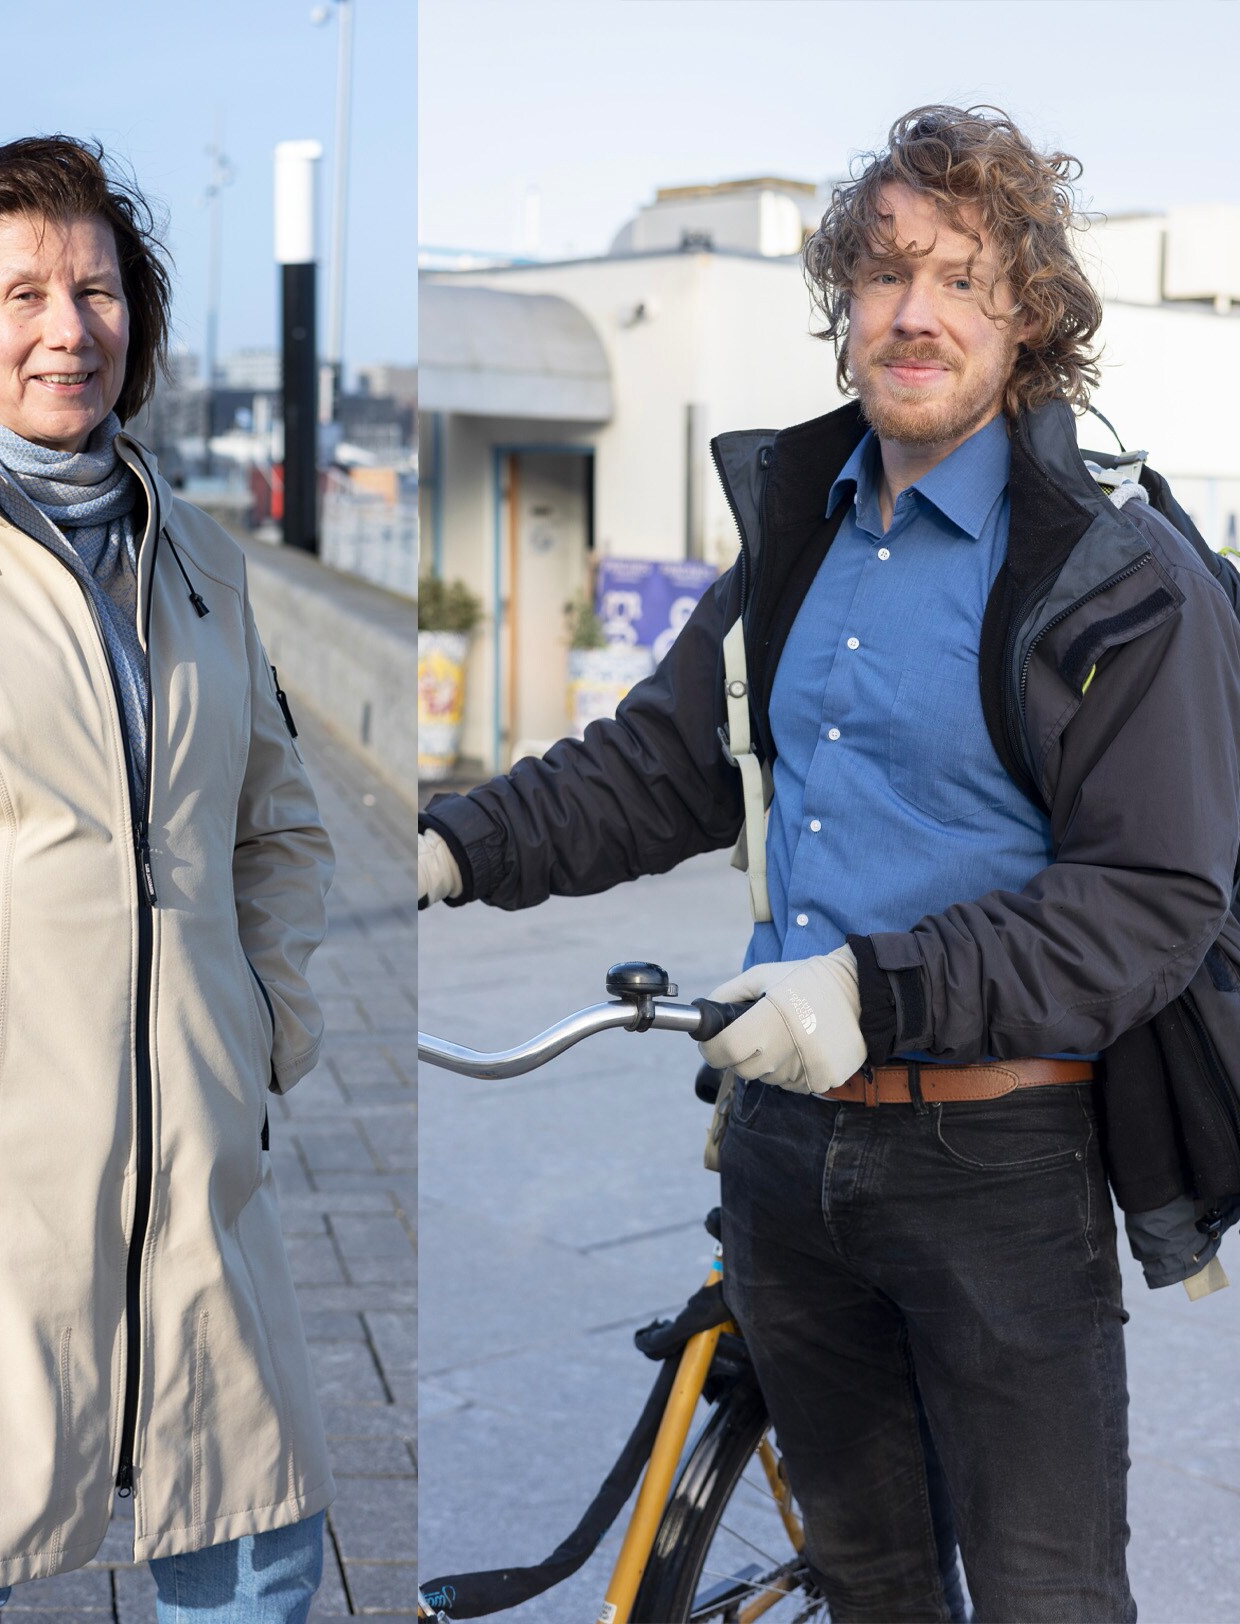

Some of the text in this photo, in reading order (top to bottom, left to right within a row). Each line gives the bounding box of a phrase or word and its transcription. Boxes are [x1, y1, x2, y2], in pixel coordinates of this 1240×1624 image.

[787, 988, 809, 1017] NORTH
[789, 997, 805, 1021] FACE
[801, 998, 813, 1013] THE
